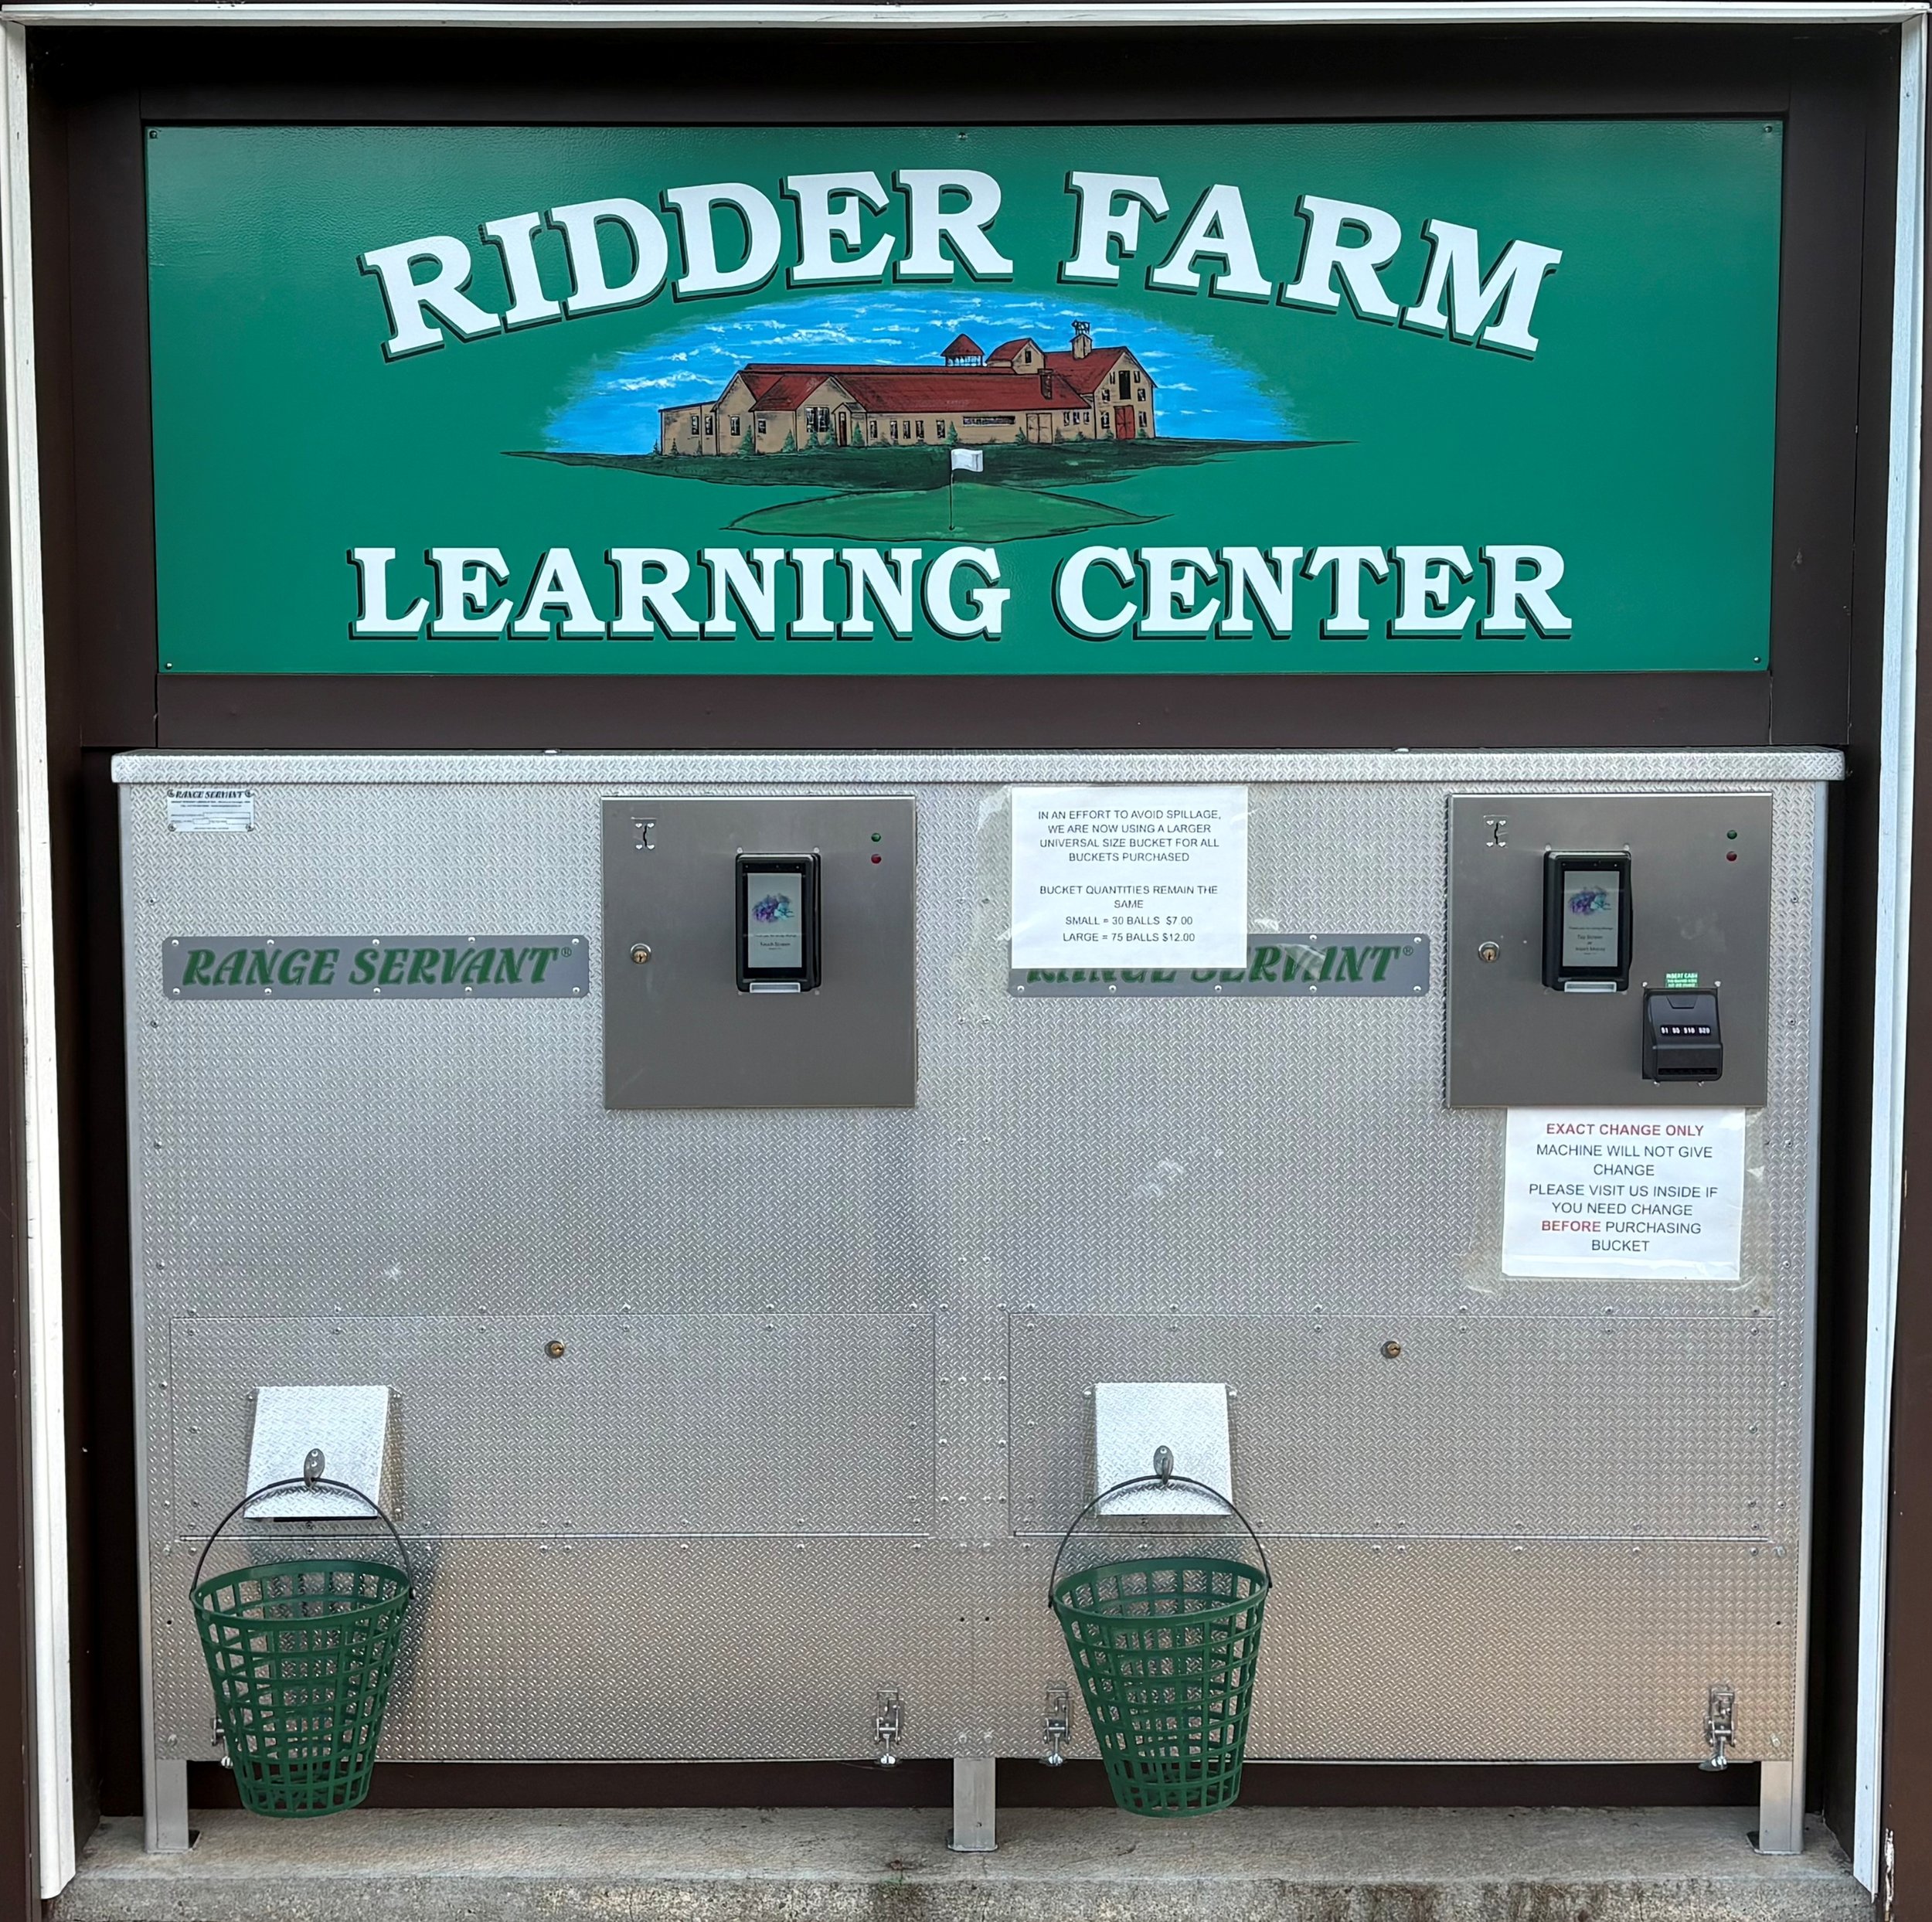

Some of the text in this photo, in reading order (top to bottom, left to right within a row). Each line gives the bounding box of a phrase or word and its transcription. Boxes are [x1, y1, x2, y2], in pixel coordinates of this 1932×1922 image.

[362, 170, 1563, 359] RIDDER FARM
[352, 546, 1573, 638] LEARNING CENTER
[1038, 809, 1222, 821] IN AN EFFORT TO AVOID SPILLAGE,
[1047, 823, 1212, 834] WE ARE NOW USING A LARGER
[1039, 838, 1220, 848] UNIVERSAL SIZE BUCKET FOR ALL
[1068, 852, 1190, 862] BUCKETS PURCHASED
[1039, 885, 1219, 895] BUCKET QUANTITIES REMAIN THE
[1114, 899, 1145, 909] SAME
[1065, 916, 1100, 926] SMALL
[1111, 916, 1124, 926] 30
[1126, 916, 1161, 926] BALLS
[1165, 916, 1193, 927] $7.00
[1063, 932, 1100, 942] LARGE
[1111, 932, 1124, 942] 75
[1125, 932, 1160, 942] BALLS
[1162, 932, 1196, 943] $12.00
[182, 947, 339, 986] RANGE
[1546, 1123, 1705, 1137] EXACT CHANGE ONLY
[1536, 1143, 1713, 1158] MACHINE WILL NOT GIVE
[1593, 1163, 1655, 1177] CHANGE
[1529, 1183, 1719, 1199] PLEASE VISIT US INSIDE IF
[1551, 1201, 1693, 1216] YOU NEED CHANGE
[1541, 1220, 1702, 1235] BEFORE PURCHASING
[1591, 1239, 1651, 1253] BUCKET
